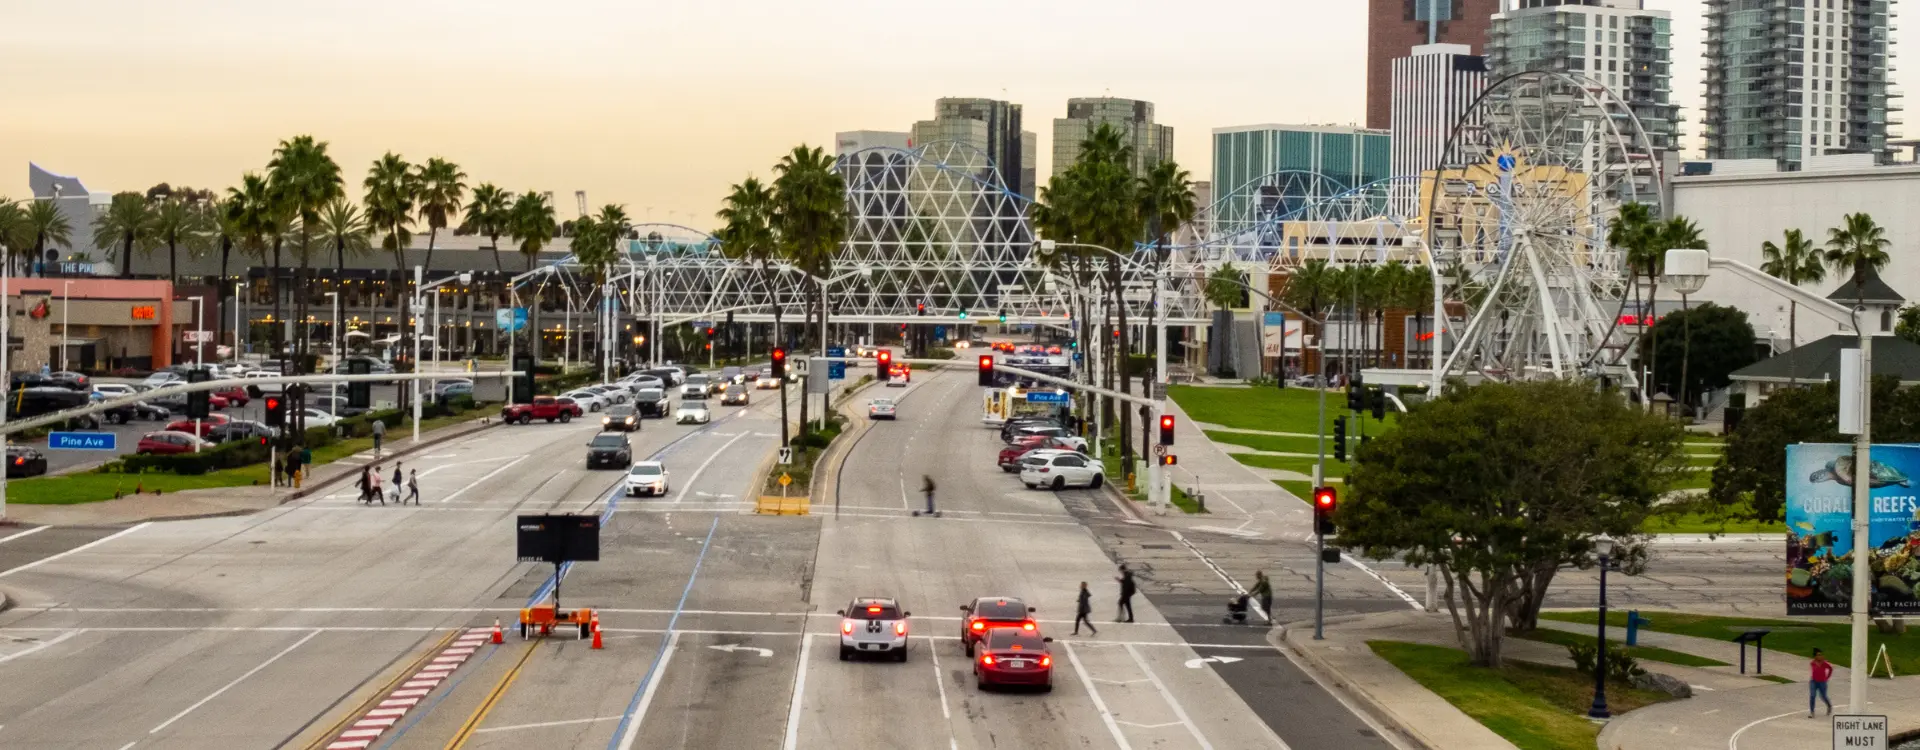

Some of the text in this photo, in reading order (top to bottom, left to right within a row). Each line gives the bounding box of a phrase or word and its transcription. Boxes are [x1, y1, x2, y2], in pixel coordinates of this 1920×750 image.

[60, 262, 76, 273] THE
[60, 436, 104, 446] Pine Ave
[1803, 496, 1917, 513] CORAL REEFS
[1791, 602, 1835, 610] AQUARIUM
[1836, 721, 1884, 730] RIGHT LANE
[1845, 736, 1875, 746] MUST
